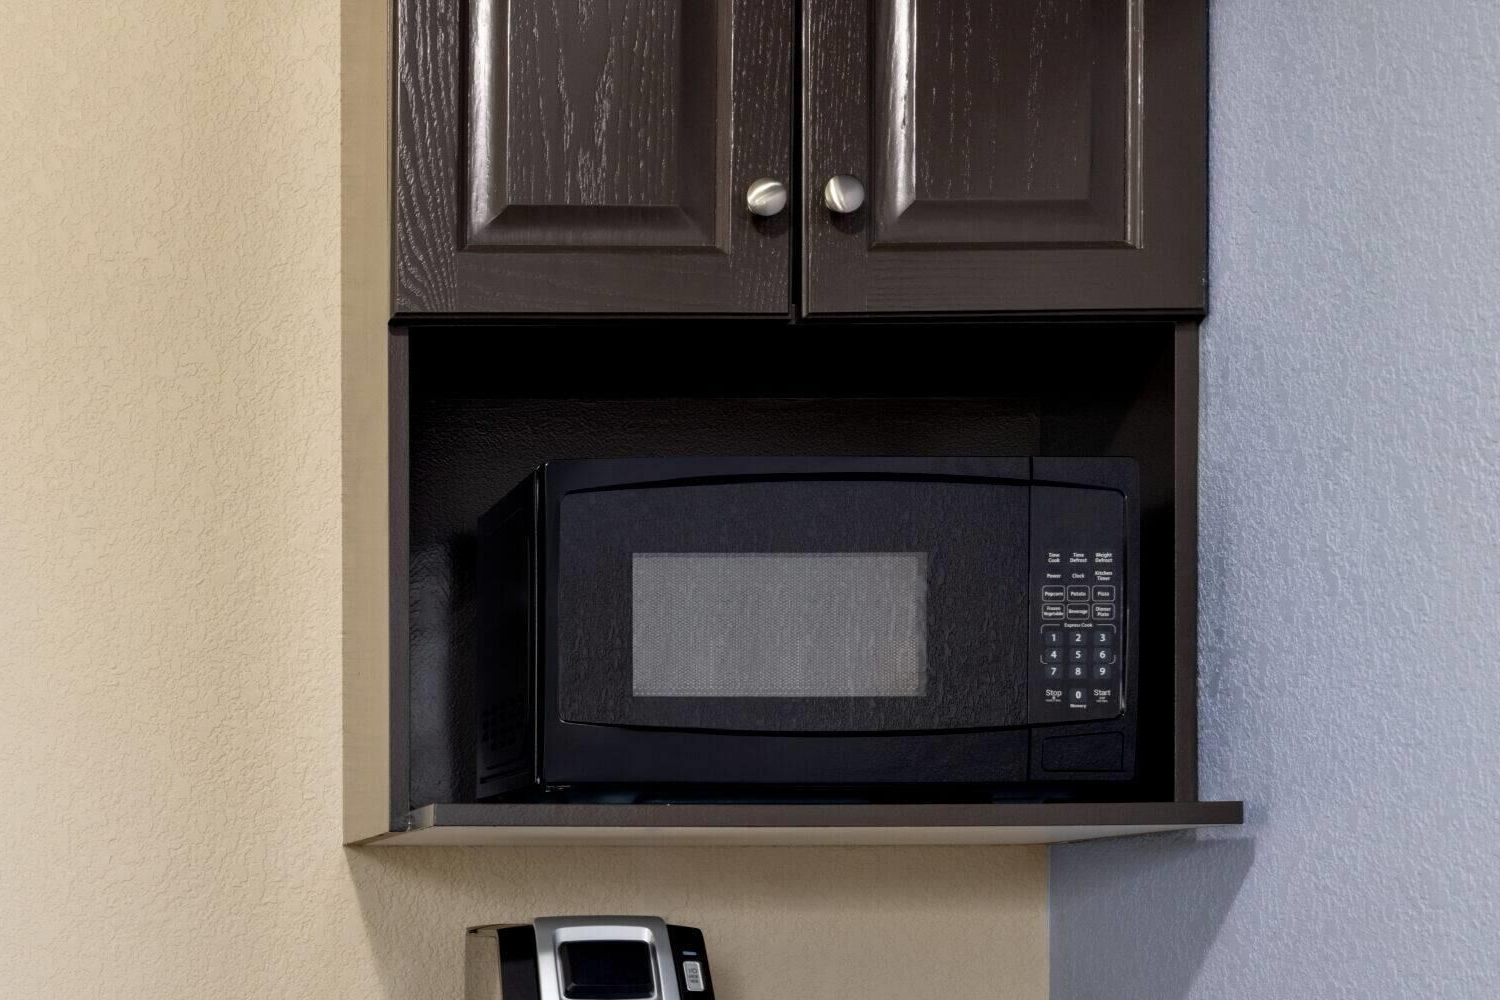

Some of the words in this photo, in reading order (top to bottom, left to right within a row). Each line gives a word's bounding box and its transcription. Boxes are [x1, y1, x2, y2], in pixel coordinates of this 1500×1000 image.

[1051, 633, 1056, 642] 1
[1075, 633, 1081, 642] 2
[1099, 633, 1105, 642] 3
[1050, 650, 1057, 659] 4
[1075, 650, 1081, 659] 5
[1099, 650, 1106, 659] 6
[1050, 667, 1057, 676] 7
[1075, 667, 1081, 676] 8
[1099, 667, 1106, 676] 9
[1045, 689, 1063, 697] Stop
[1075, 690, 1082, 699] 0
